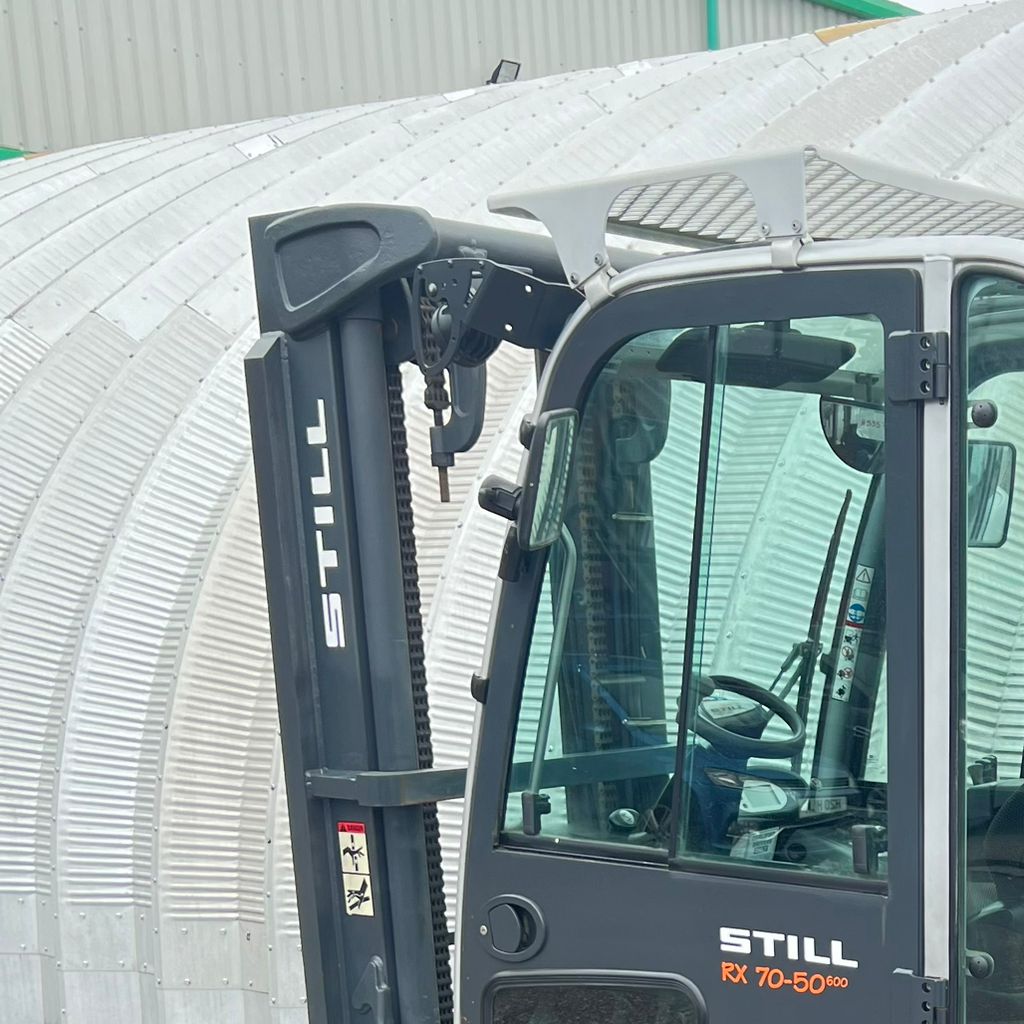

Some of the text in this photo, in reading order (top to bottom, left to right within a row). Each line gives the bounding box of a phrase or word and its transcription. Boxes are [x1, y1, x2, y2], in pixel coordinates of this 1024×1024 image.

[306, 398, 346, 648] STILL
[719, 926, 859, 969] STILL
[721, 961, 748, 985] RX
